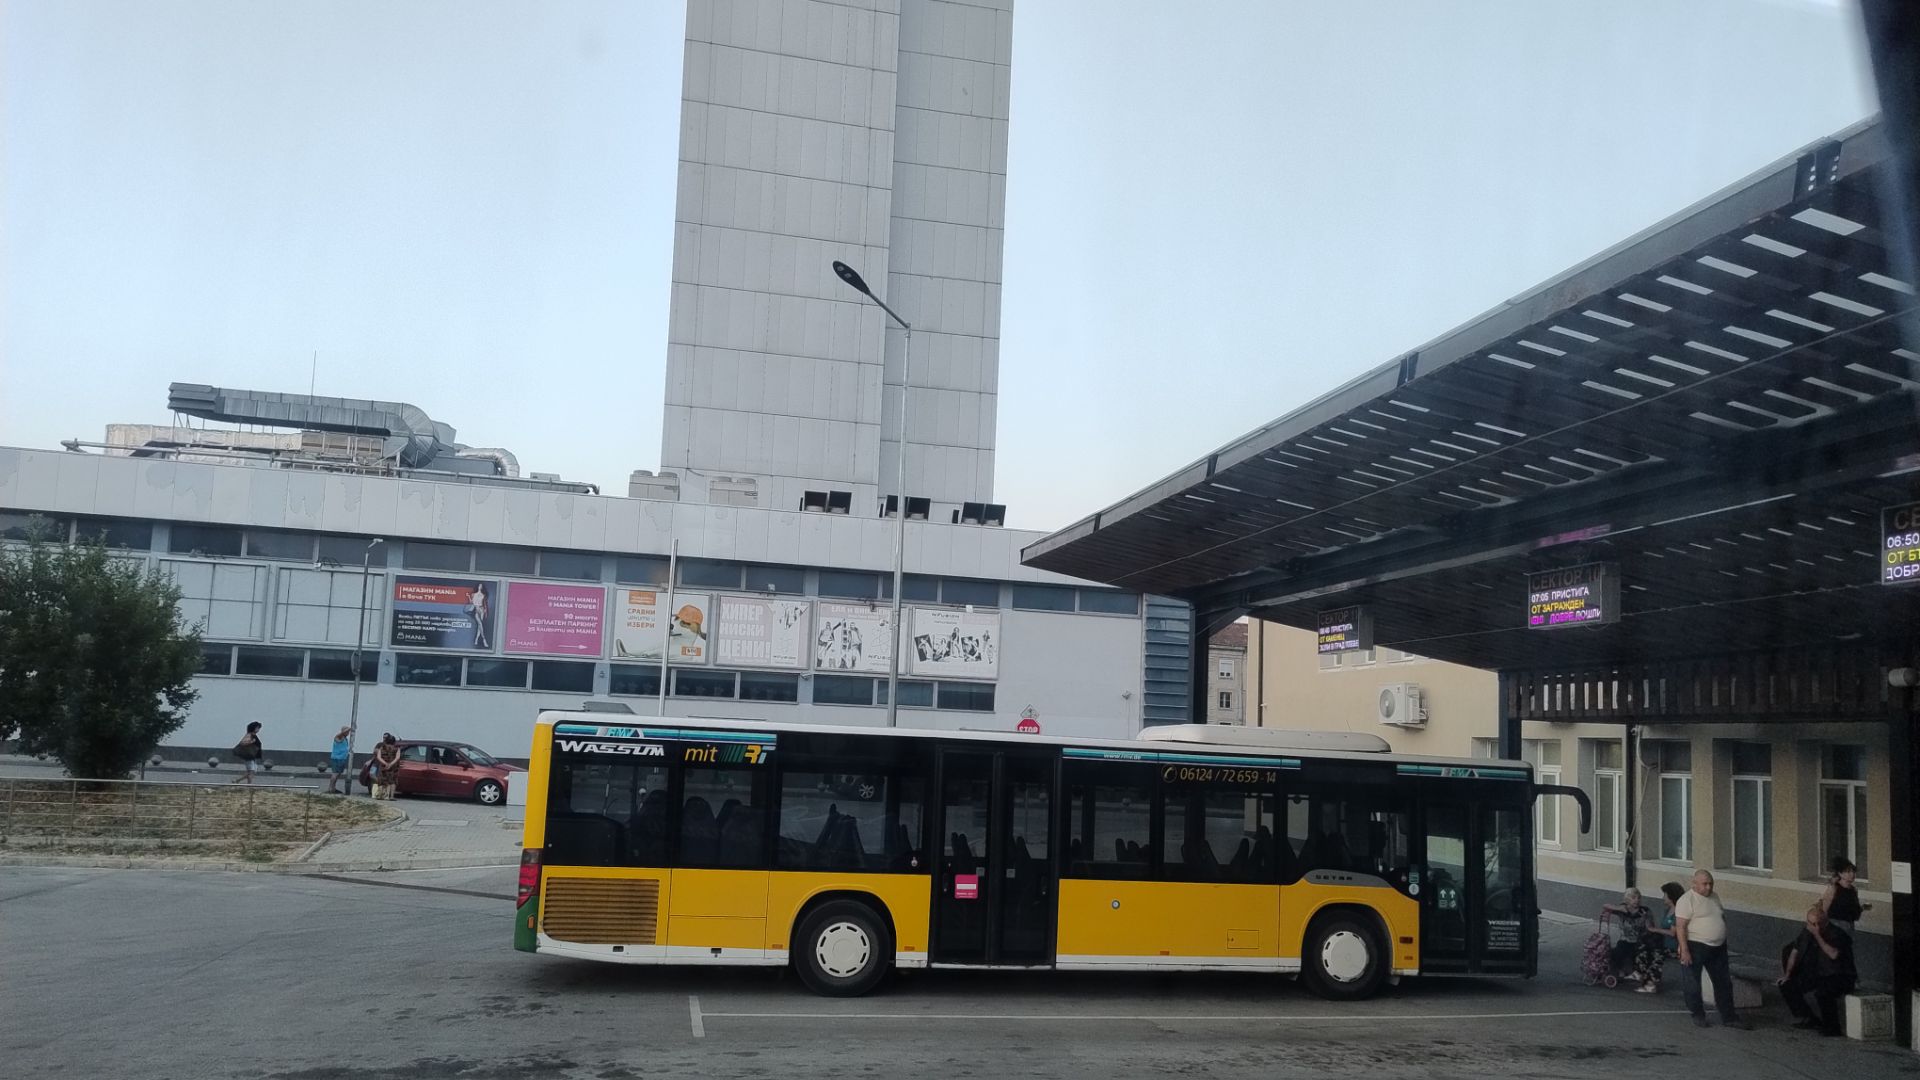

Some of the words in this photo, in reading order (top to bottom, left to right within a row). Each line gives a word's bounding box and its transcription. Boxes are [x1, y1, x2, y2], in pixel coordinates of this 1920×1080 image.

[1887, 532, 1919, 548] 06:50
[1887, 551, 1905, 564] ОТ
[1532, 568, 1583, 591] СЕКТОР
[402, 586, 434, 594] МАГАЗИН
[1531, 592, 1549, 603] 07:05
[1551, 586, 1589, 600] ПРИСТИГА
[547, 595, 576, 603] МАГАЗИН
[1531, 604, 1541, 614] ОТ
[1542, 599, 1584, 613] ЗАГРАЖДЕН
[721, 603, 764, 621] ХИПЕР
[529, 618, 567, 626] БЕЗПЛАТЕН
[567, 620, 598, 628] ПАРКИНГ
[720, 622, 765, 637] НИСКИ
[719, 639, 771, 659] ЦЕНИ!
[555, 739, 664, 756] WASSUM
[684, 744, 719, 763] mit
[1180, 767, 1212, 781] 06124
